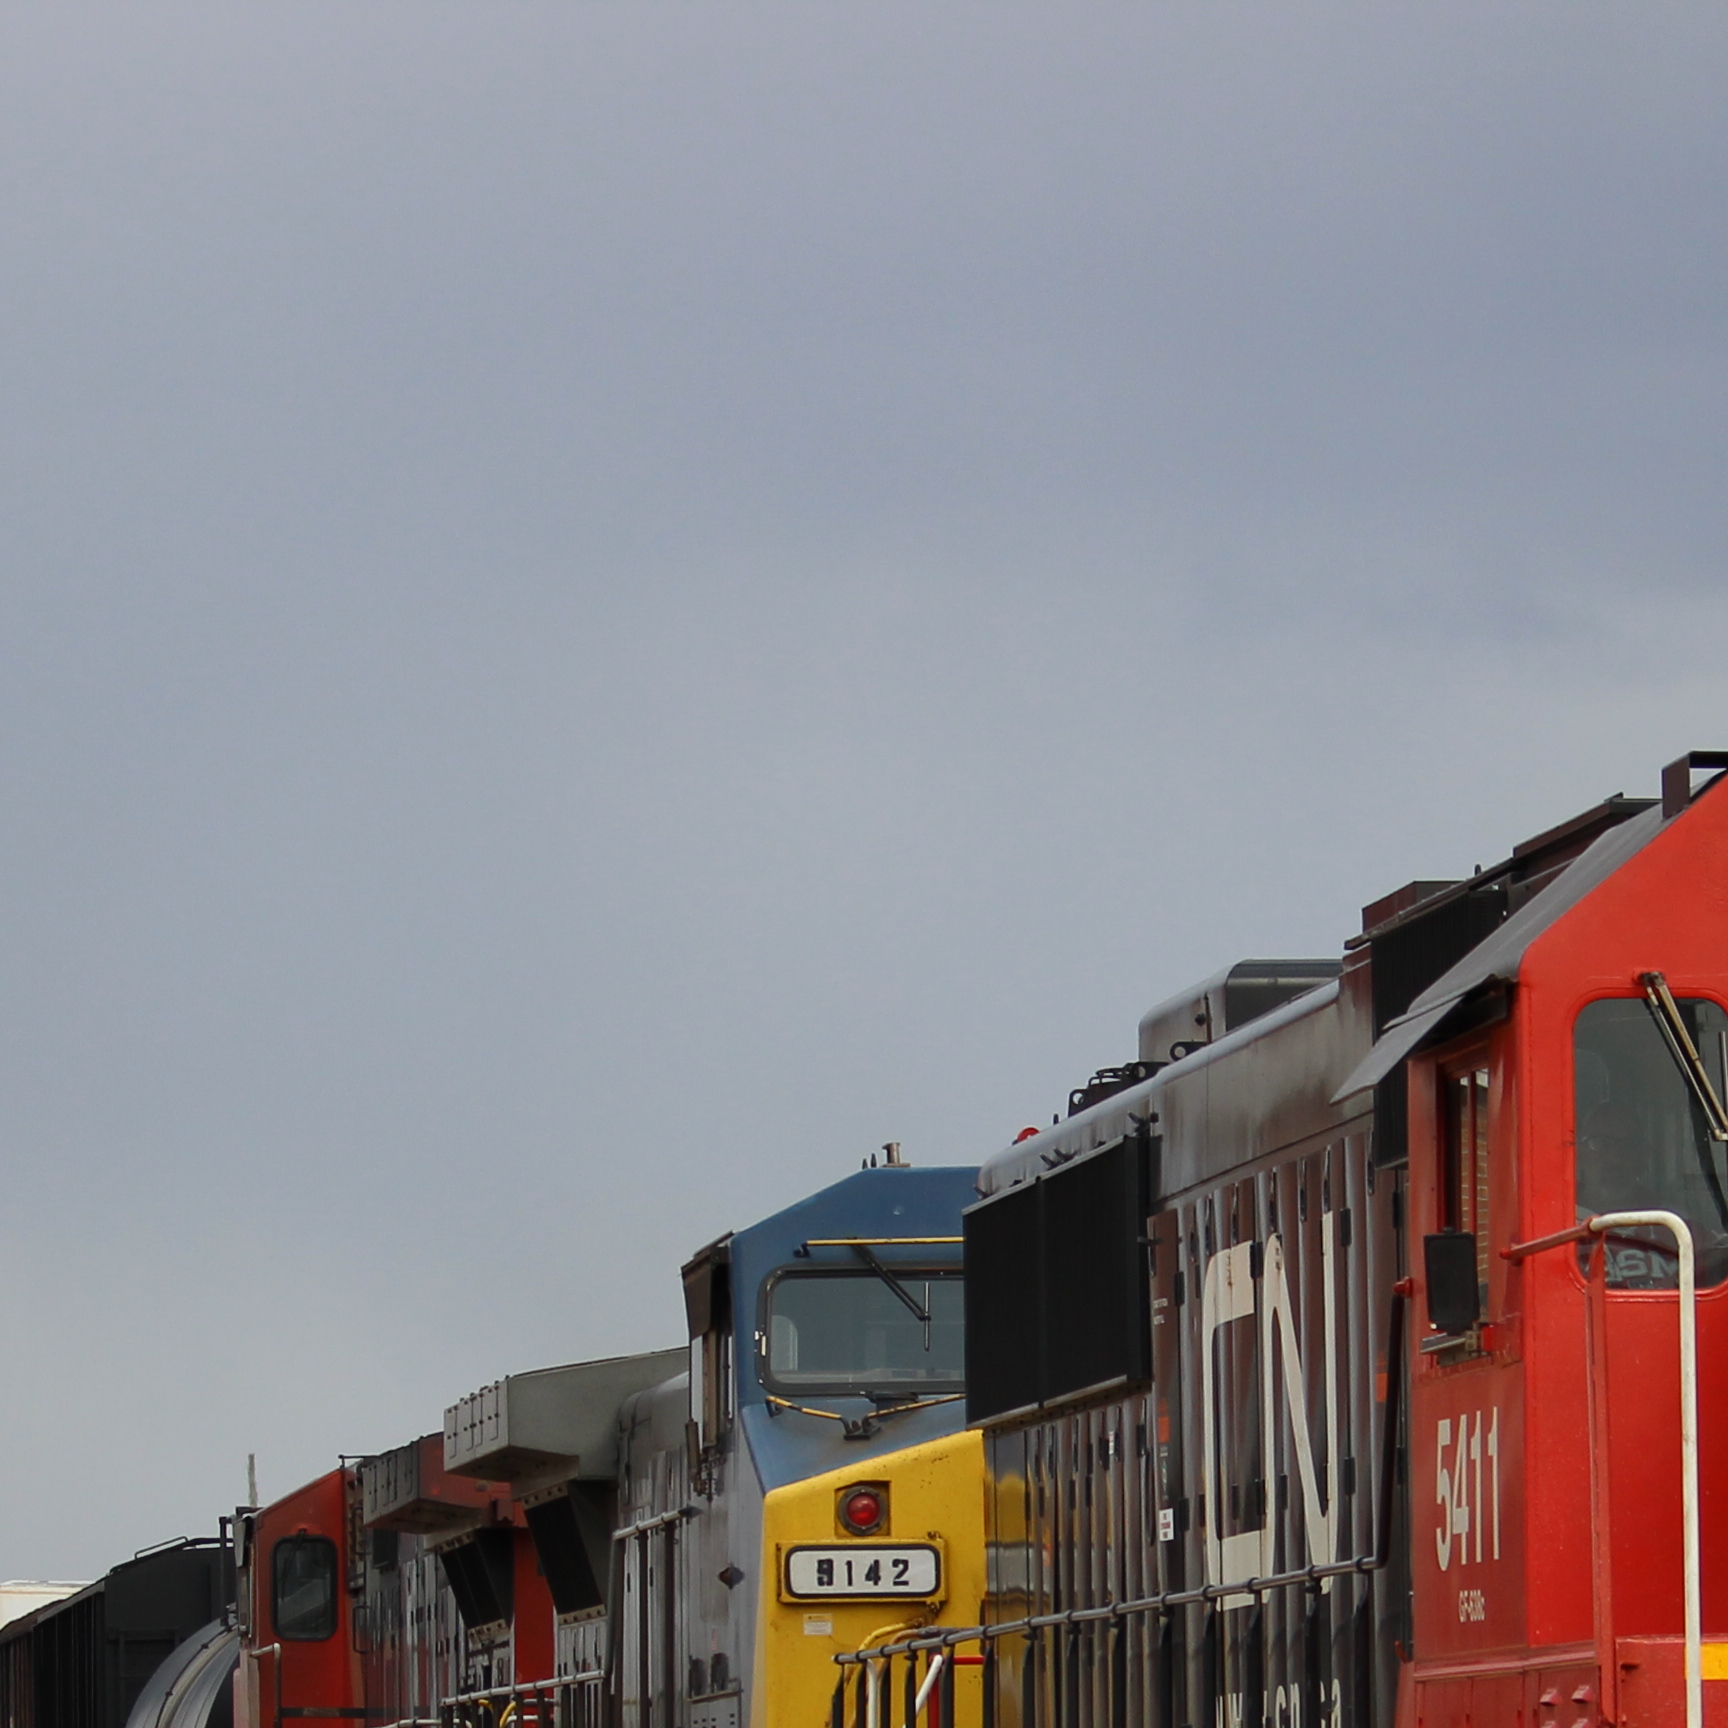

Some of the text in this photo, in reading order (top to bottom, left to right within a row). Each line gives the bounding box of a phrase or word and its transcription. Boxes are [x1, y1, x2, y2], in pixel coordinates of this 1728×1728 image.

[1202, 1211, 1338, 1612] CN
[1436, 1406, 1499, 1571] 5411
[816, 1558, 909, 1587] 9142
